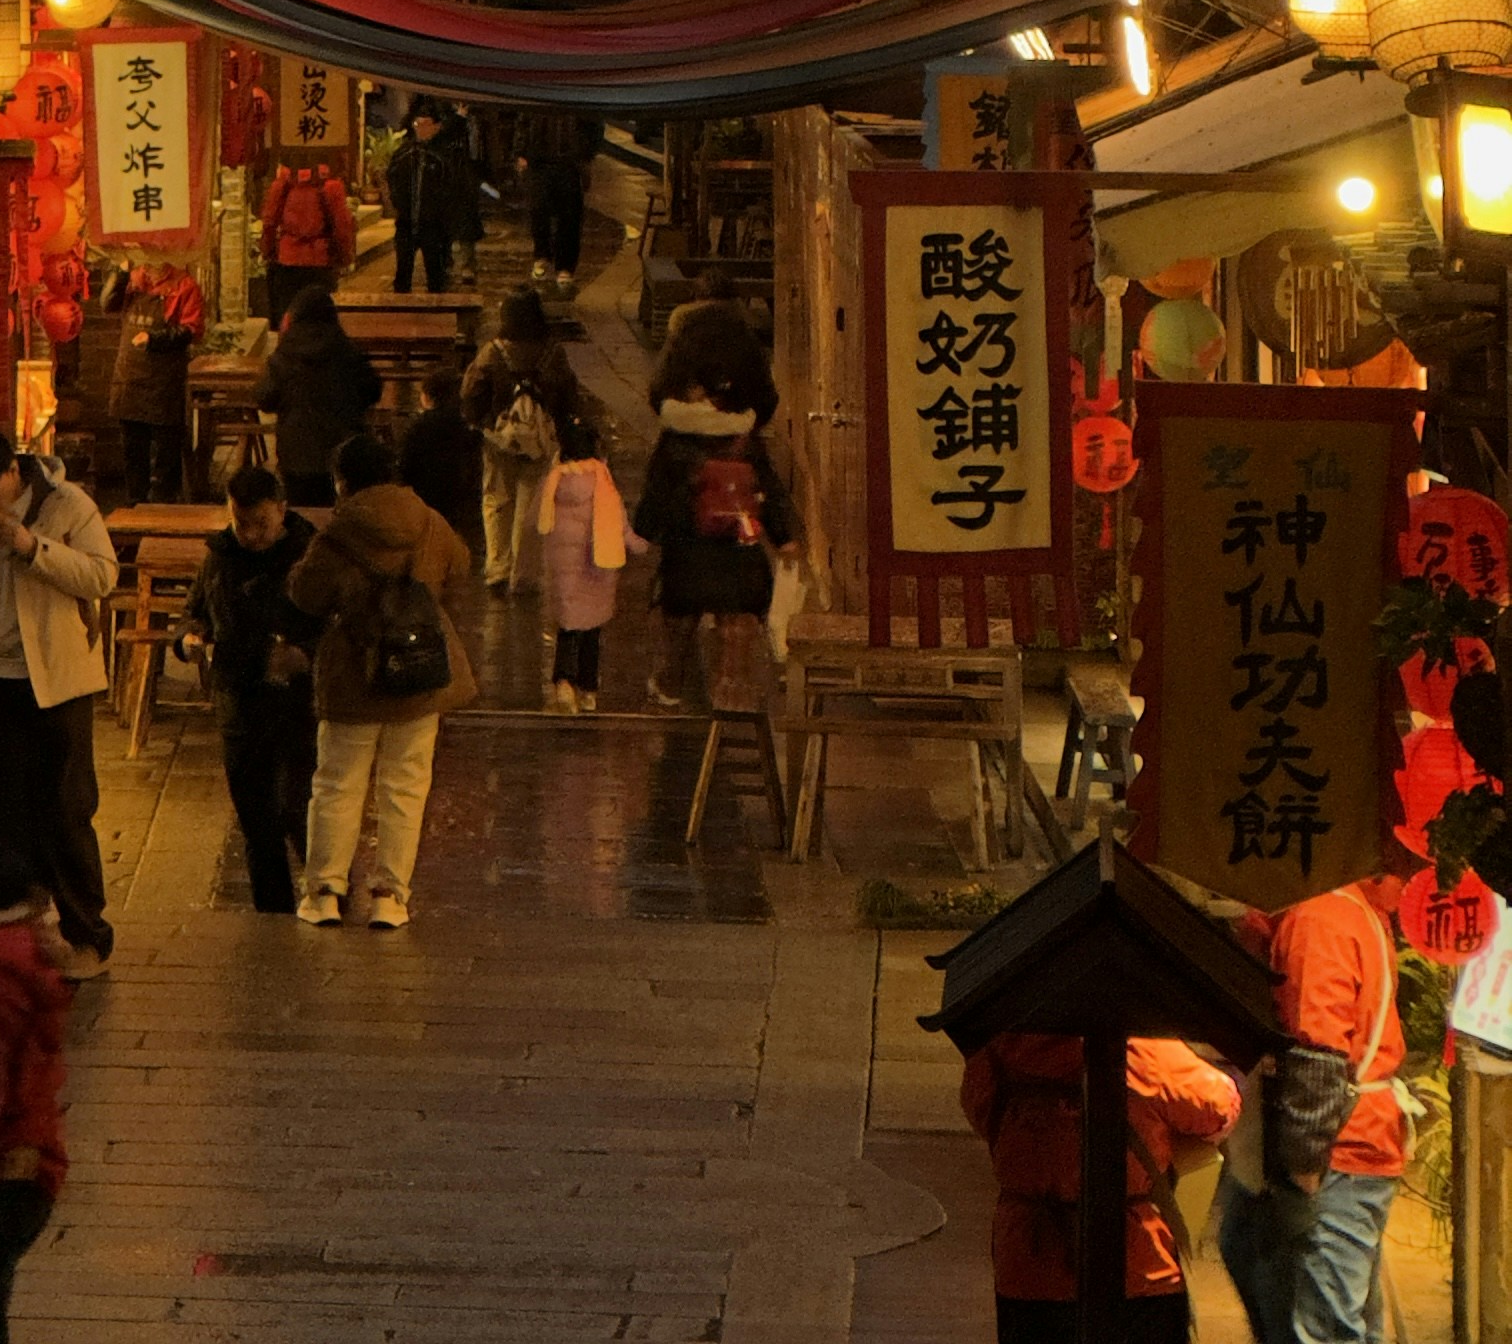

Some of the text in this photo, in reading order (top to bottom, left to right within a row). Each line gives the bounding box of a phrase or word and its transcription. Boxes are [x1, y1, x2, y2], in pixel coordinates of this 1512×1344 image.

[37, 85, 73, 123] 福
[118, 56, 165, 222] 夸父炸串
[916, 229, 1026, 530] 酸奶鋪子
[1221, 494, 1332, 878] 神仙功夫餅
[1425, 892, 1484, 954] 福
